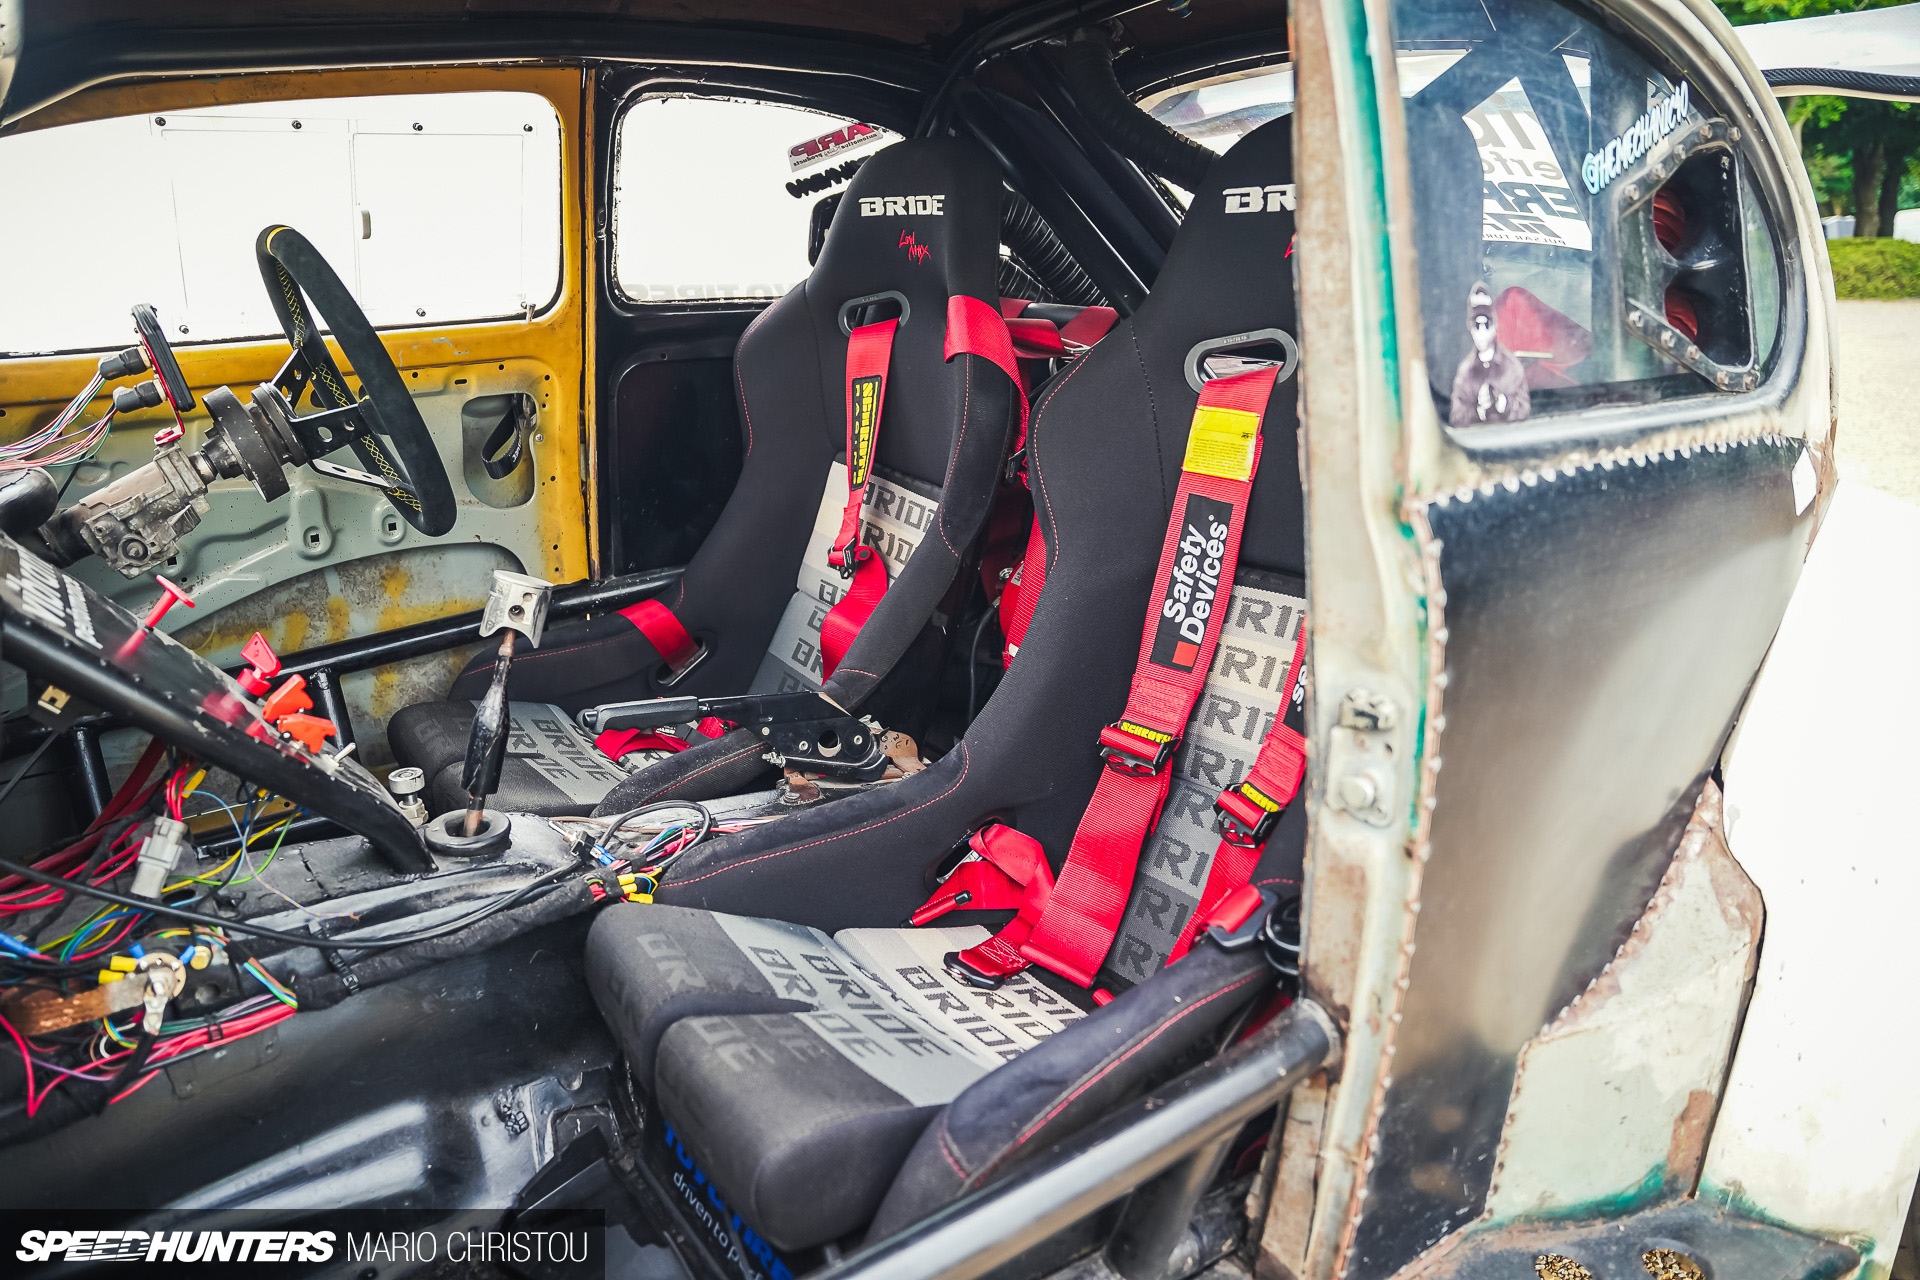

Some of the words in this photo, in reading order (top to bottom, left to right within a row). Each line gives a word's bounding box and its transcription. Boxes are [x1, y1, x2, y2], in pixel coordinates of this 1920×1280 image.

[859, 194, 945, 216] BRIDE
[1222, 183, 1297, 214] BR
[1163, 524, 1207, 622] Safety
[1180, 521, 1228, 644] Devices
